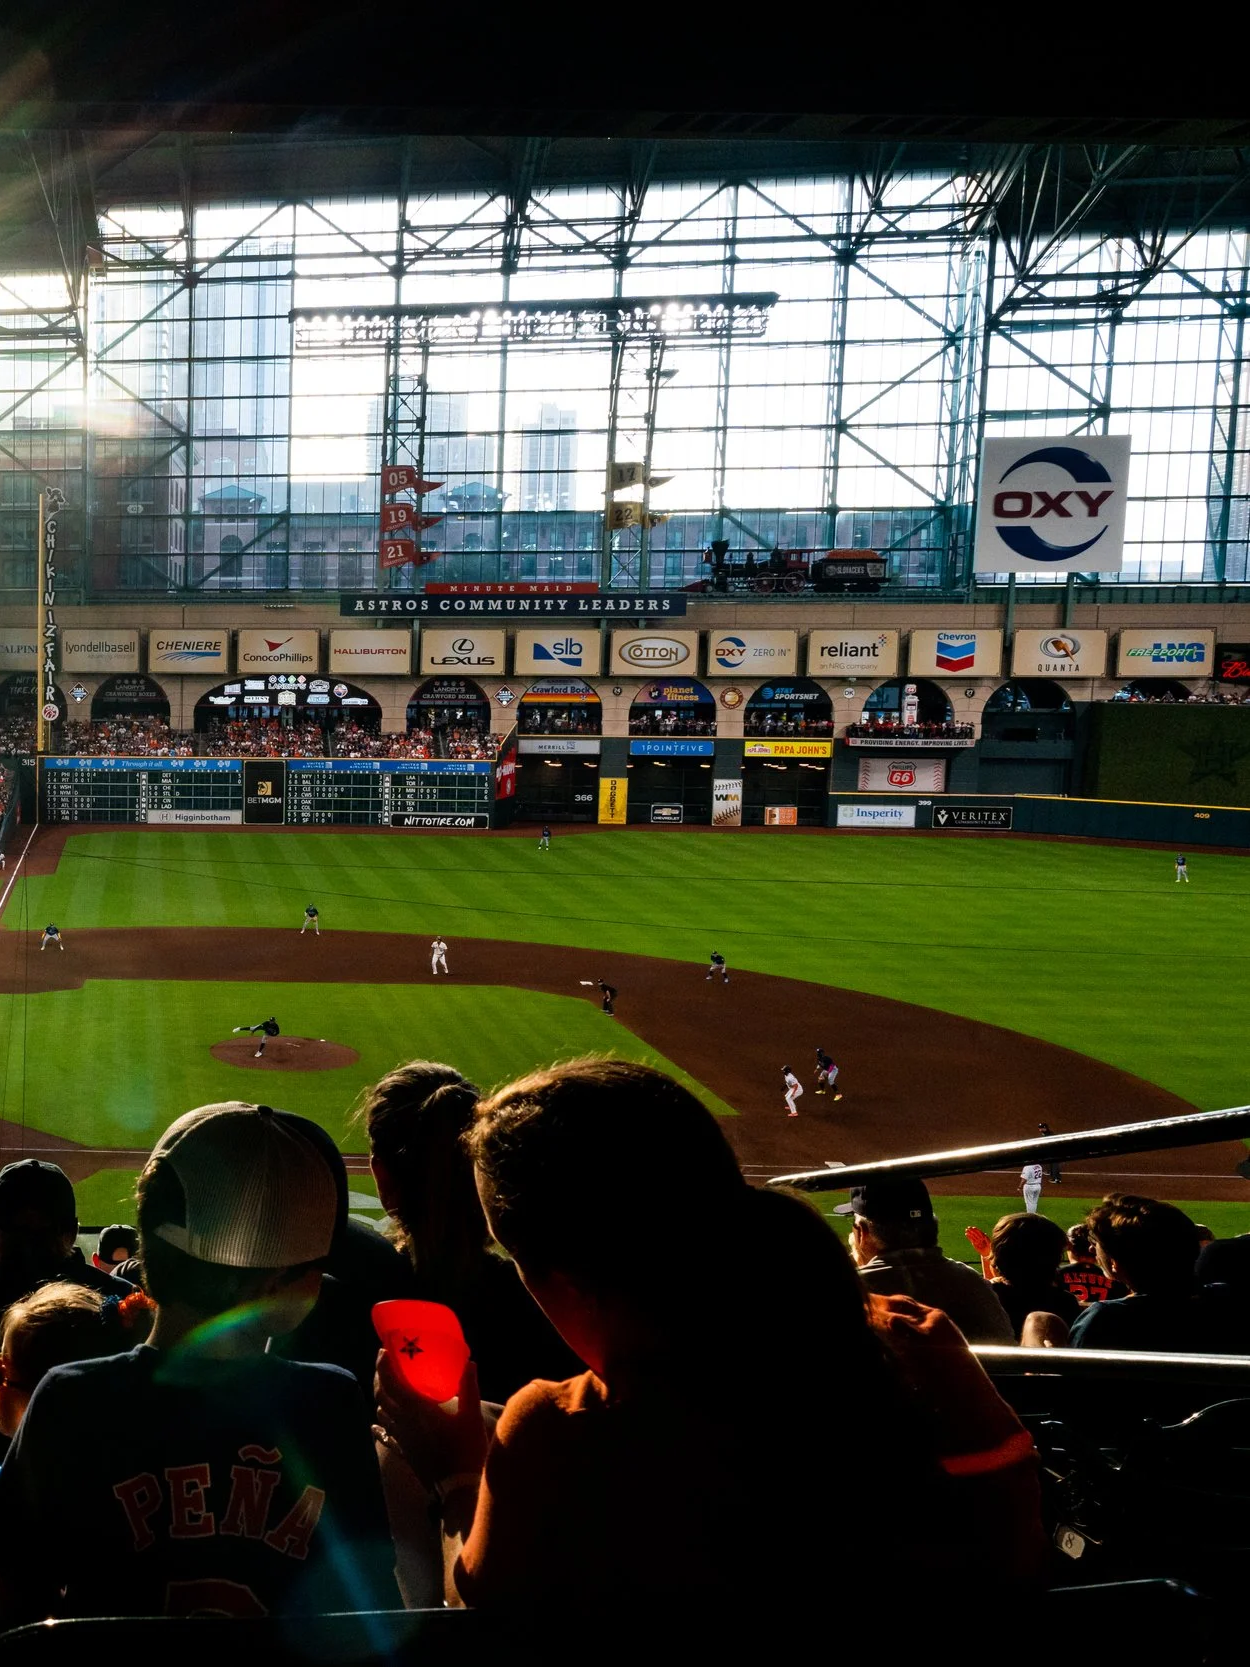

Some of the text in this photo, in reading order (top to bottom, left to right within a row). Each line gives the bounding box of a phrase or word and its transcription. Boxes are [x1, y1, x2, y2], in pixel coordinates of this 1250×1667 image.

[389, 471, 408, 486] 05
[617, 467, 636, 482] 17
[992, 490, 1115, 518] OXY
[389, 510, 407, 523] 19
[615, 508, 633, 521] 22
[387, 545, 404, 559] 21
[354, 599, 671, 611] ASTROS COMMUNITY LEADERS
[937, 632, 976, 641] Chevron
[65, 641, 135, 654] lyondellbasell
[157, 641, 222, 651] CHENIERE
[553, 638, 583, 656] slb
[820, 642, 879, 657] reliant
[628, 644, 679, 661] COTTON
[715, 648, 746, 656] OXY
[753, 648, 775, 657] ZERO
[1126, 648, 1193, 656] FREEPORT
[1152, 643, 1205, 662] LNG
[243, 653, 313, 664] ConocoPhillips
[431, 656, 495, 665] LEXUS
[1038, 664, 1080, 672] QUANTA
[532, 686, 591, 694] Crawford Bock
[663, 686, 694, 697] planet
[667, 692, 699, 701] fitness
[642, 744, 704, 752] 1POINTFIVE
[774, 745, 827, 754] PAPA JOHN'S
[121, 760, 148, 769] Through
[892, 772, 911, 782] 66
[175, 813, 230, 822] Higginbotham
[856, 808, 904, 820] Insperity
[952, 812, 1006, 821] VERITEX
[404, 816, 475, 827] NITTOTIRE.COM
[1034, 1170, 1042, 1179] 22
[1063, 1272, 1113, 1288] ALTUVE
[1070, 1284, 1108, 1302] 27
[112, 1444, 326, 1561] PEÑA
